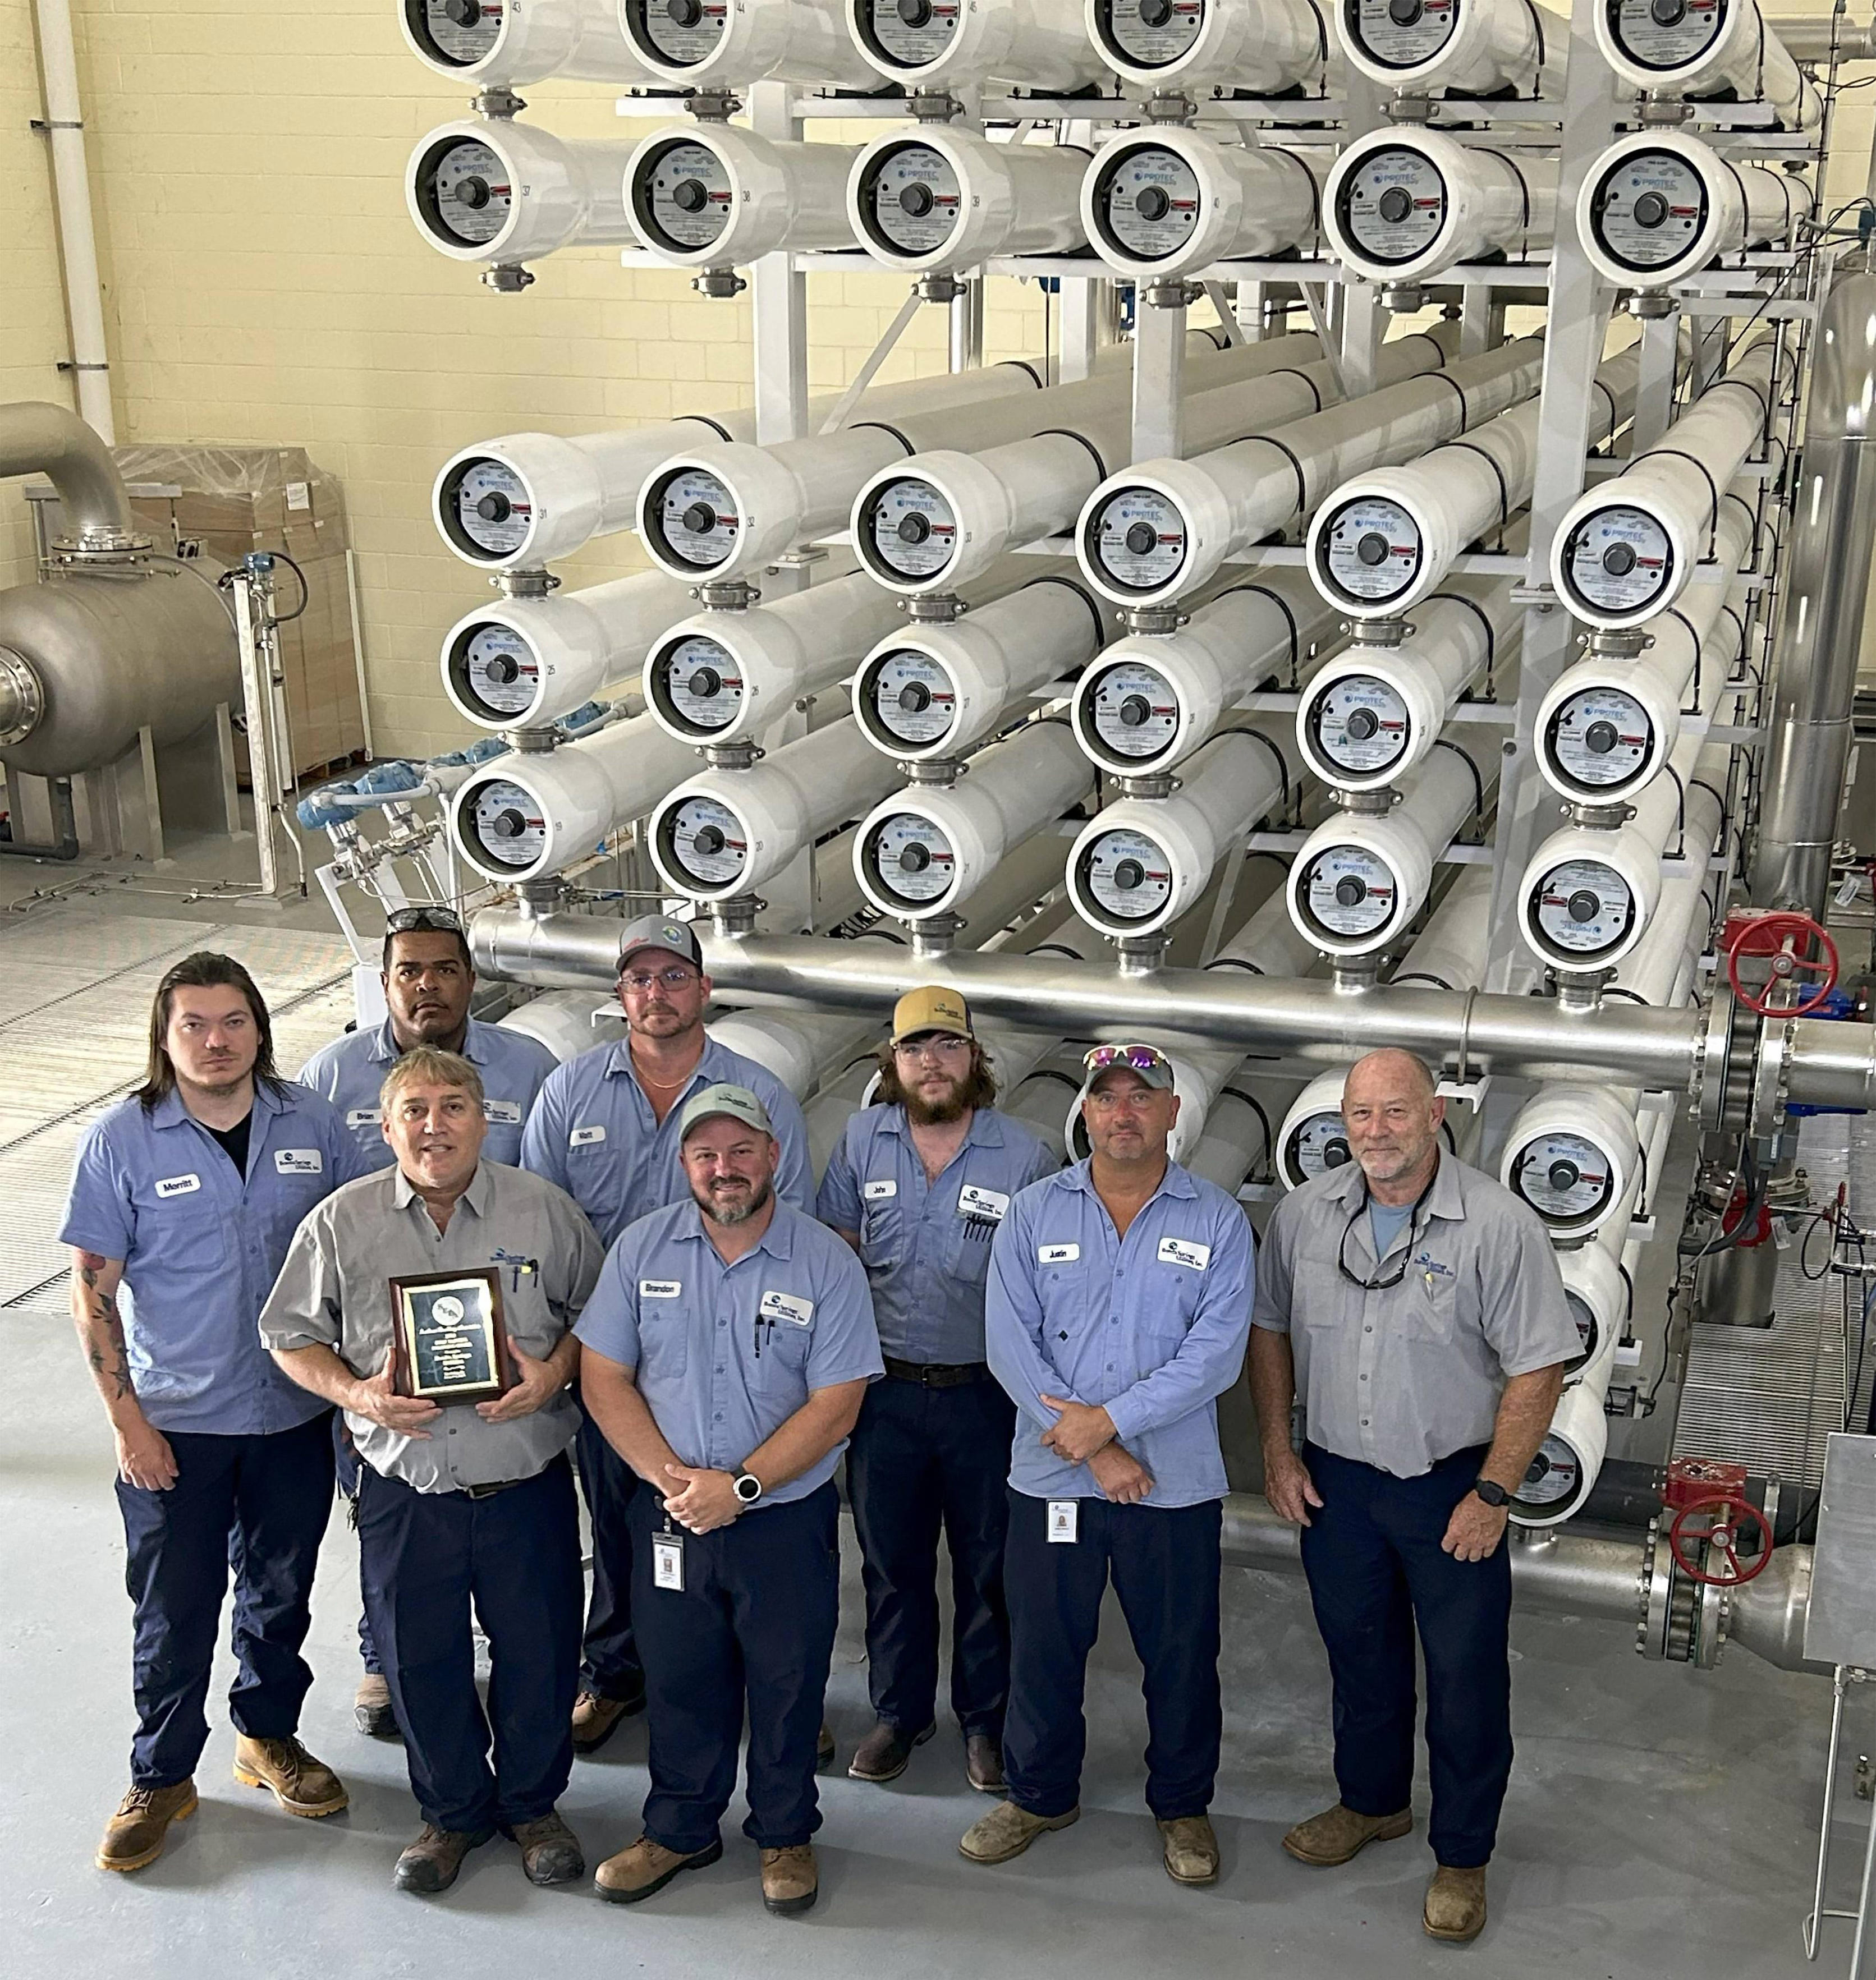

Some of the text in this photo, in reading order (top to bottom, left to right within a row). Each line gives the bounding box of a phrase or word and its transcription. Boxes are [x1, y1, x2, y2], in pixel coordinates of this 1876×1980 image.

[1612, 530, 1643, 539] PROTEC
[163, 1179, 193, 1191] Merritt
[1049, 1249, 1067, 1258] Justin
[645, 1283, 675, 1293] Brandon
